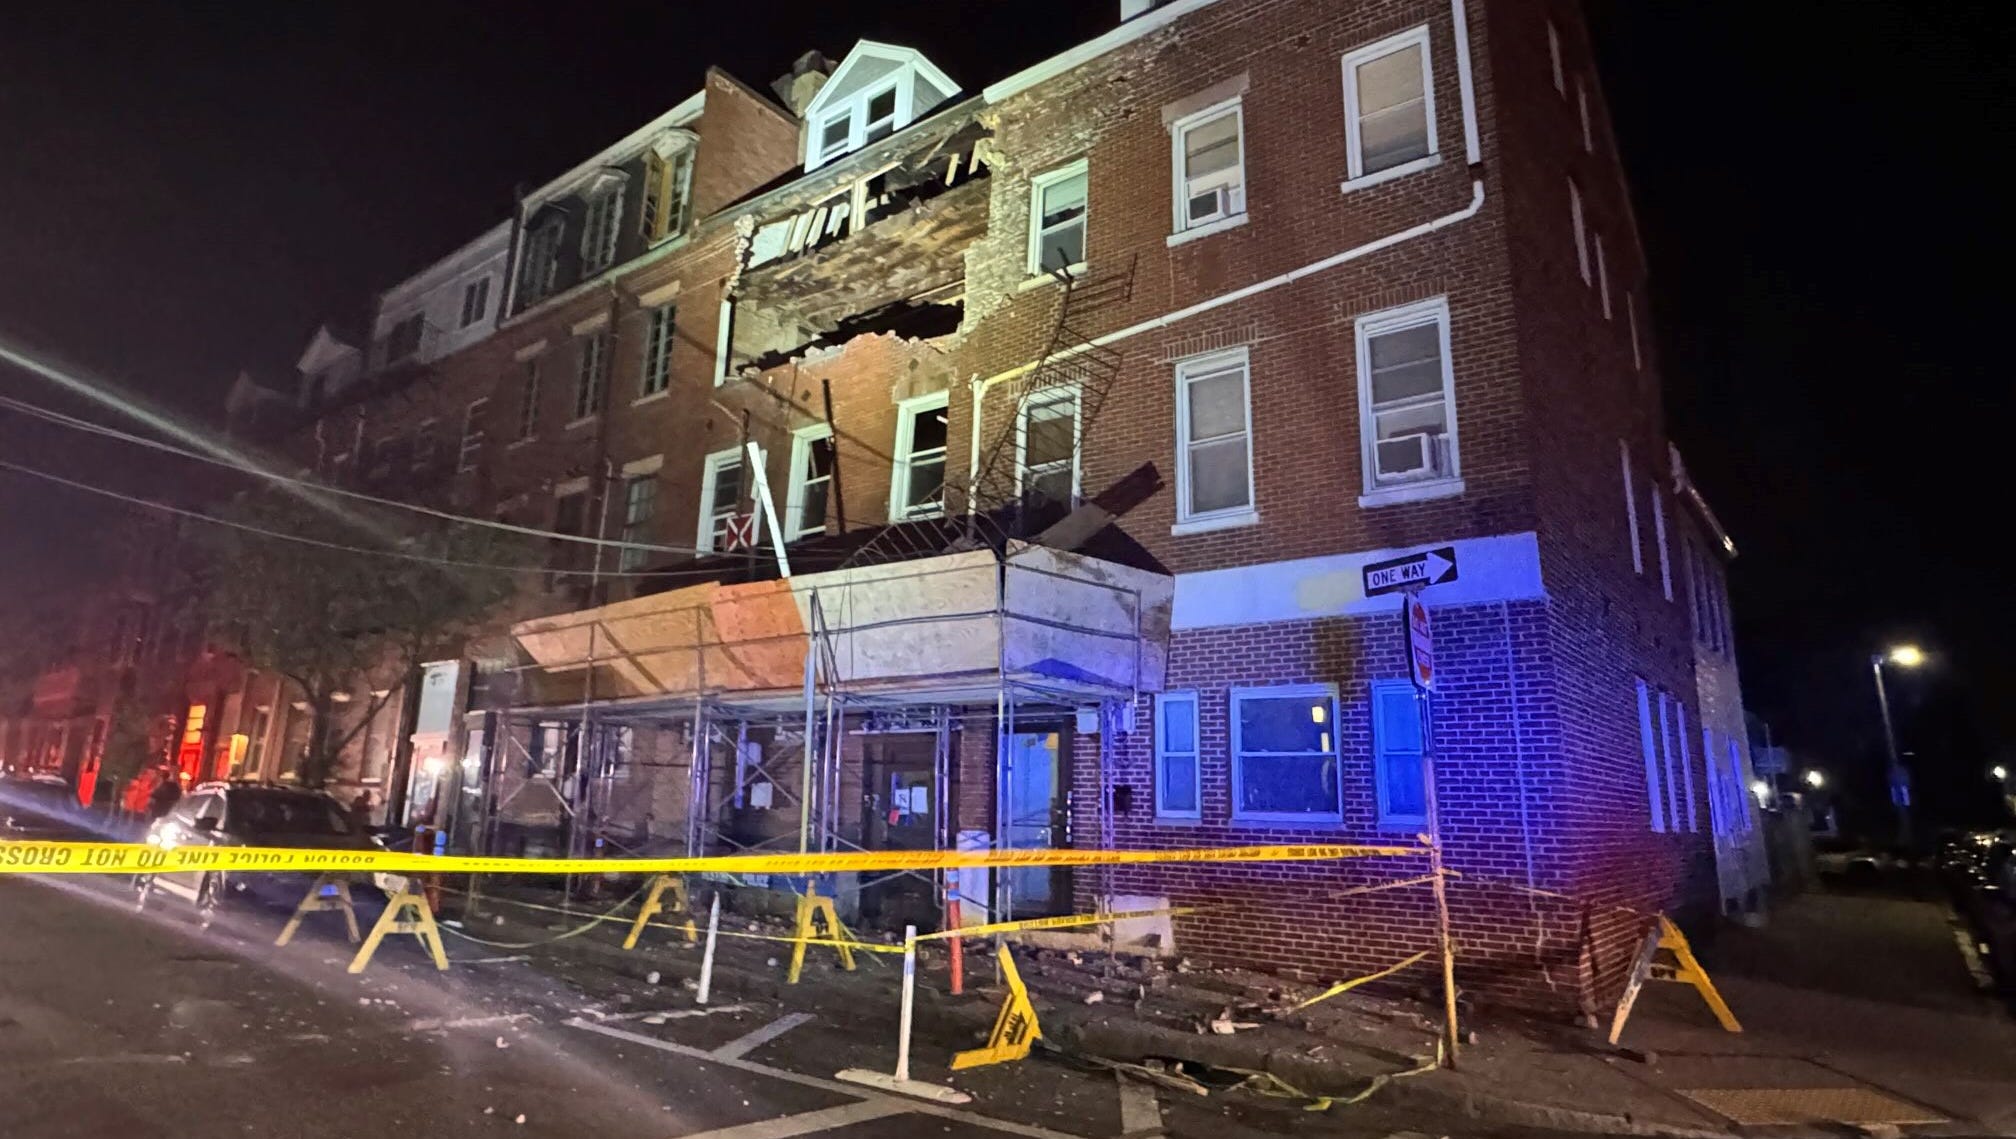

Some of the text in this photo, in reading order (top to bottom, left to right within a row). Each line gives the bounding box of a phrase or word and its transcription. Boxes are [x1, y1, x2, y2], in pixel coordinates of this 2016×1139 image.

[1372, 562, 1425, 586] ONE WAY
[80, 847, 128, 867] NOT
[137, 849, 168, 867] DO
[177, 851, 220, 865] LINE
